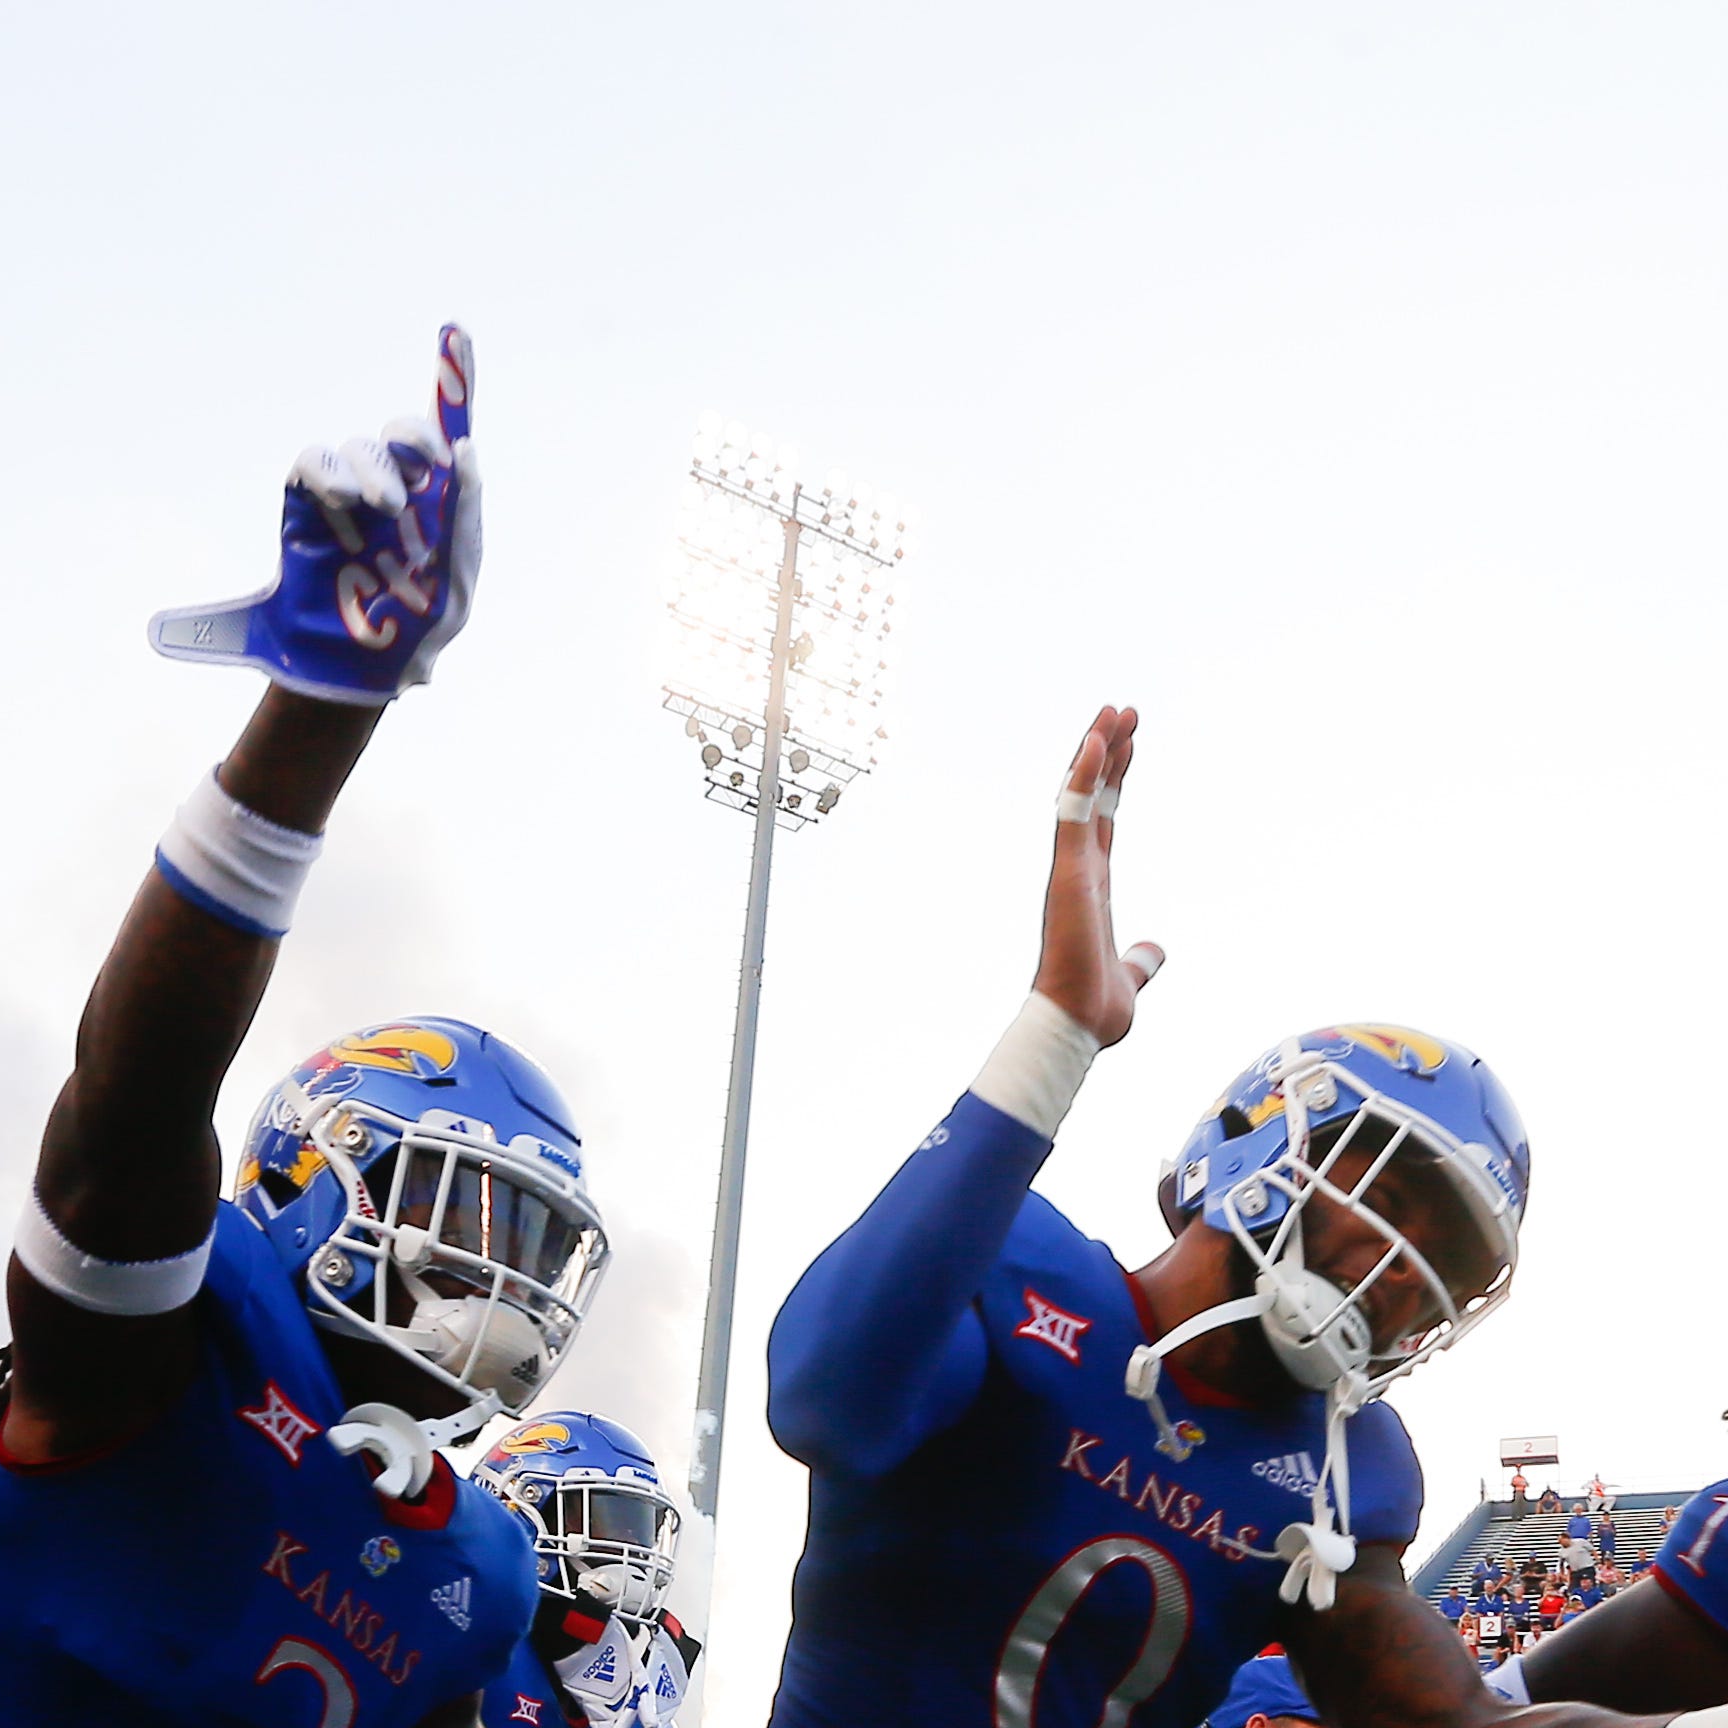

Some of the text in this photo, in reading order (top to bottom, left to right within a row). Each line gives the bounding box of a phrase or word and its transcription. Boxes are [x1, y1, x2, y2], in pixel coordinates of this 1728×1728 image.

[1523, 1442, 1533, 1453] 2
[1059, 1428, 1261, 1562] KANSAS
[1251, 1461, 1328, 1499] adida
[263, 1531, 423, 1686] KANSAS
[431, 1587, 471, 1632] adidas
[1486, 1621, 1495, 1633] 2
[583, 1645, 614, 1680] adidas
